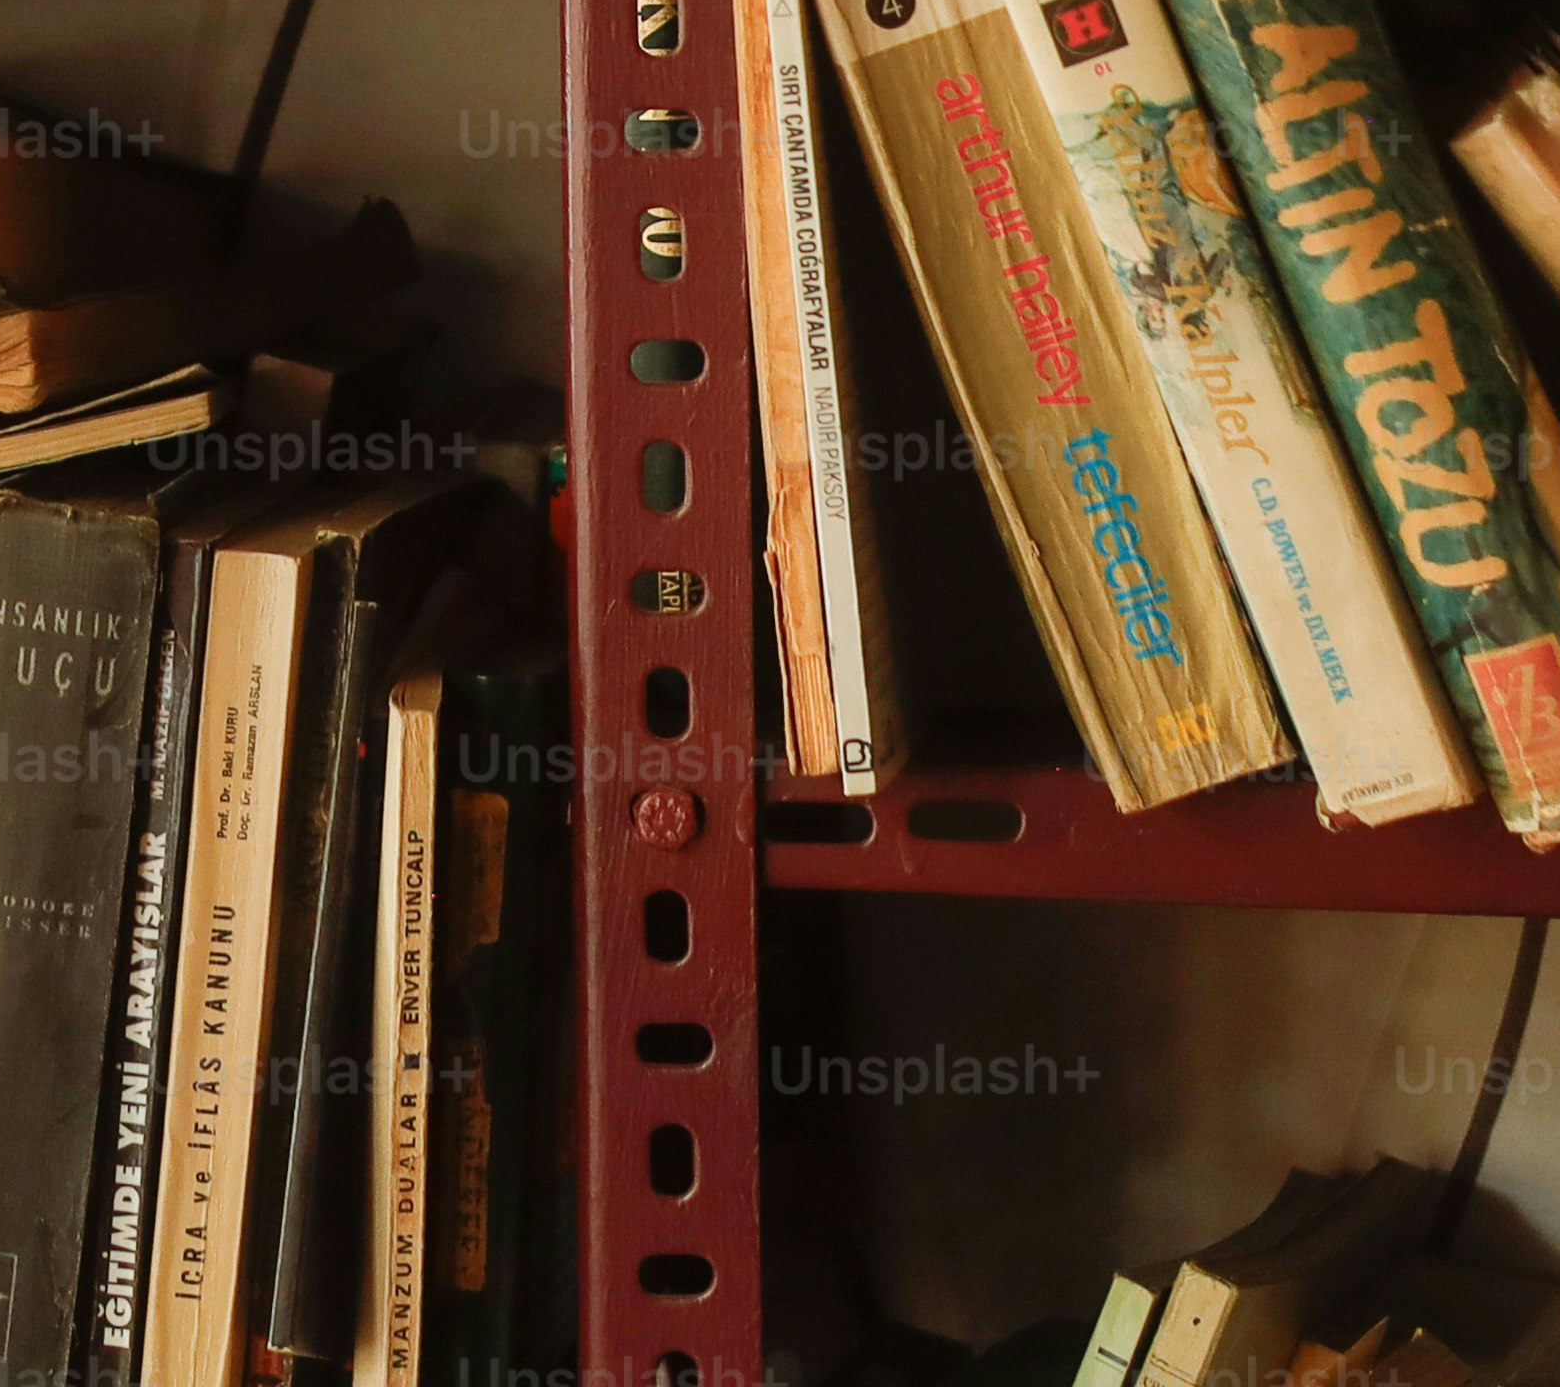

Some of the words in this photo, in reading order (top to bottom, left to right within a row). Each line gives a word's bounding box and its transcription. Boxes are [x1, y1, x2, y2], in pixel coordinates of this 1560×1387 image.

[778, 63, 801, 110] SIRT
[778, 112, 814, 228] ÇANTAMDA
[794, 228, 831, 371] COĞRAFYALAR
[935, 71, 1031, 244] arthur
[1002, 253, 1092, 409] hailey
[1168, 272, 1269, 464] Kalpler
[1249, 22, 1417, 304] ALTIN
[1343, 299, 1506, 589] TOZU
[1063, 426, 1183, 667] tefeciler
[123, 832, 166, 1048] ARAYIŞLAR
[407, 829, 428, 933] TUNCALP
[205, 904, 236, 1036] KANUNU
[402, 939, 422, 1027] ENVER
[119, 1056, 150, 1160] YENİ
[185, 1056, 225, 1155] İFLÂS
[396, 1093, 418, 1215] DUALAR
[192, 1166, 212, 1203] ve
[96, 1165, 144, 1349] EĞİTİMDE
[176, 1222, 209, 1302] İCRA
[392, 1232, 414, 1368] MANZUM
